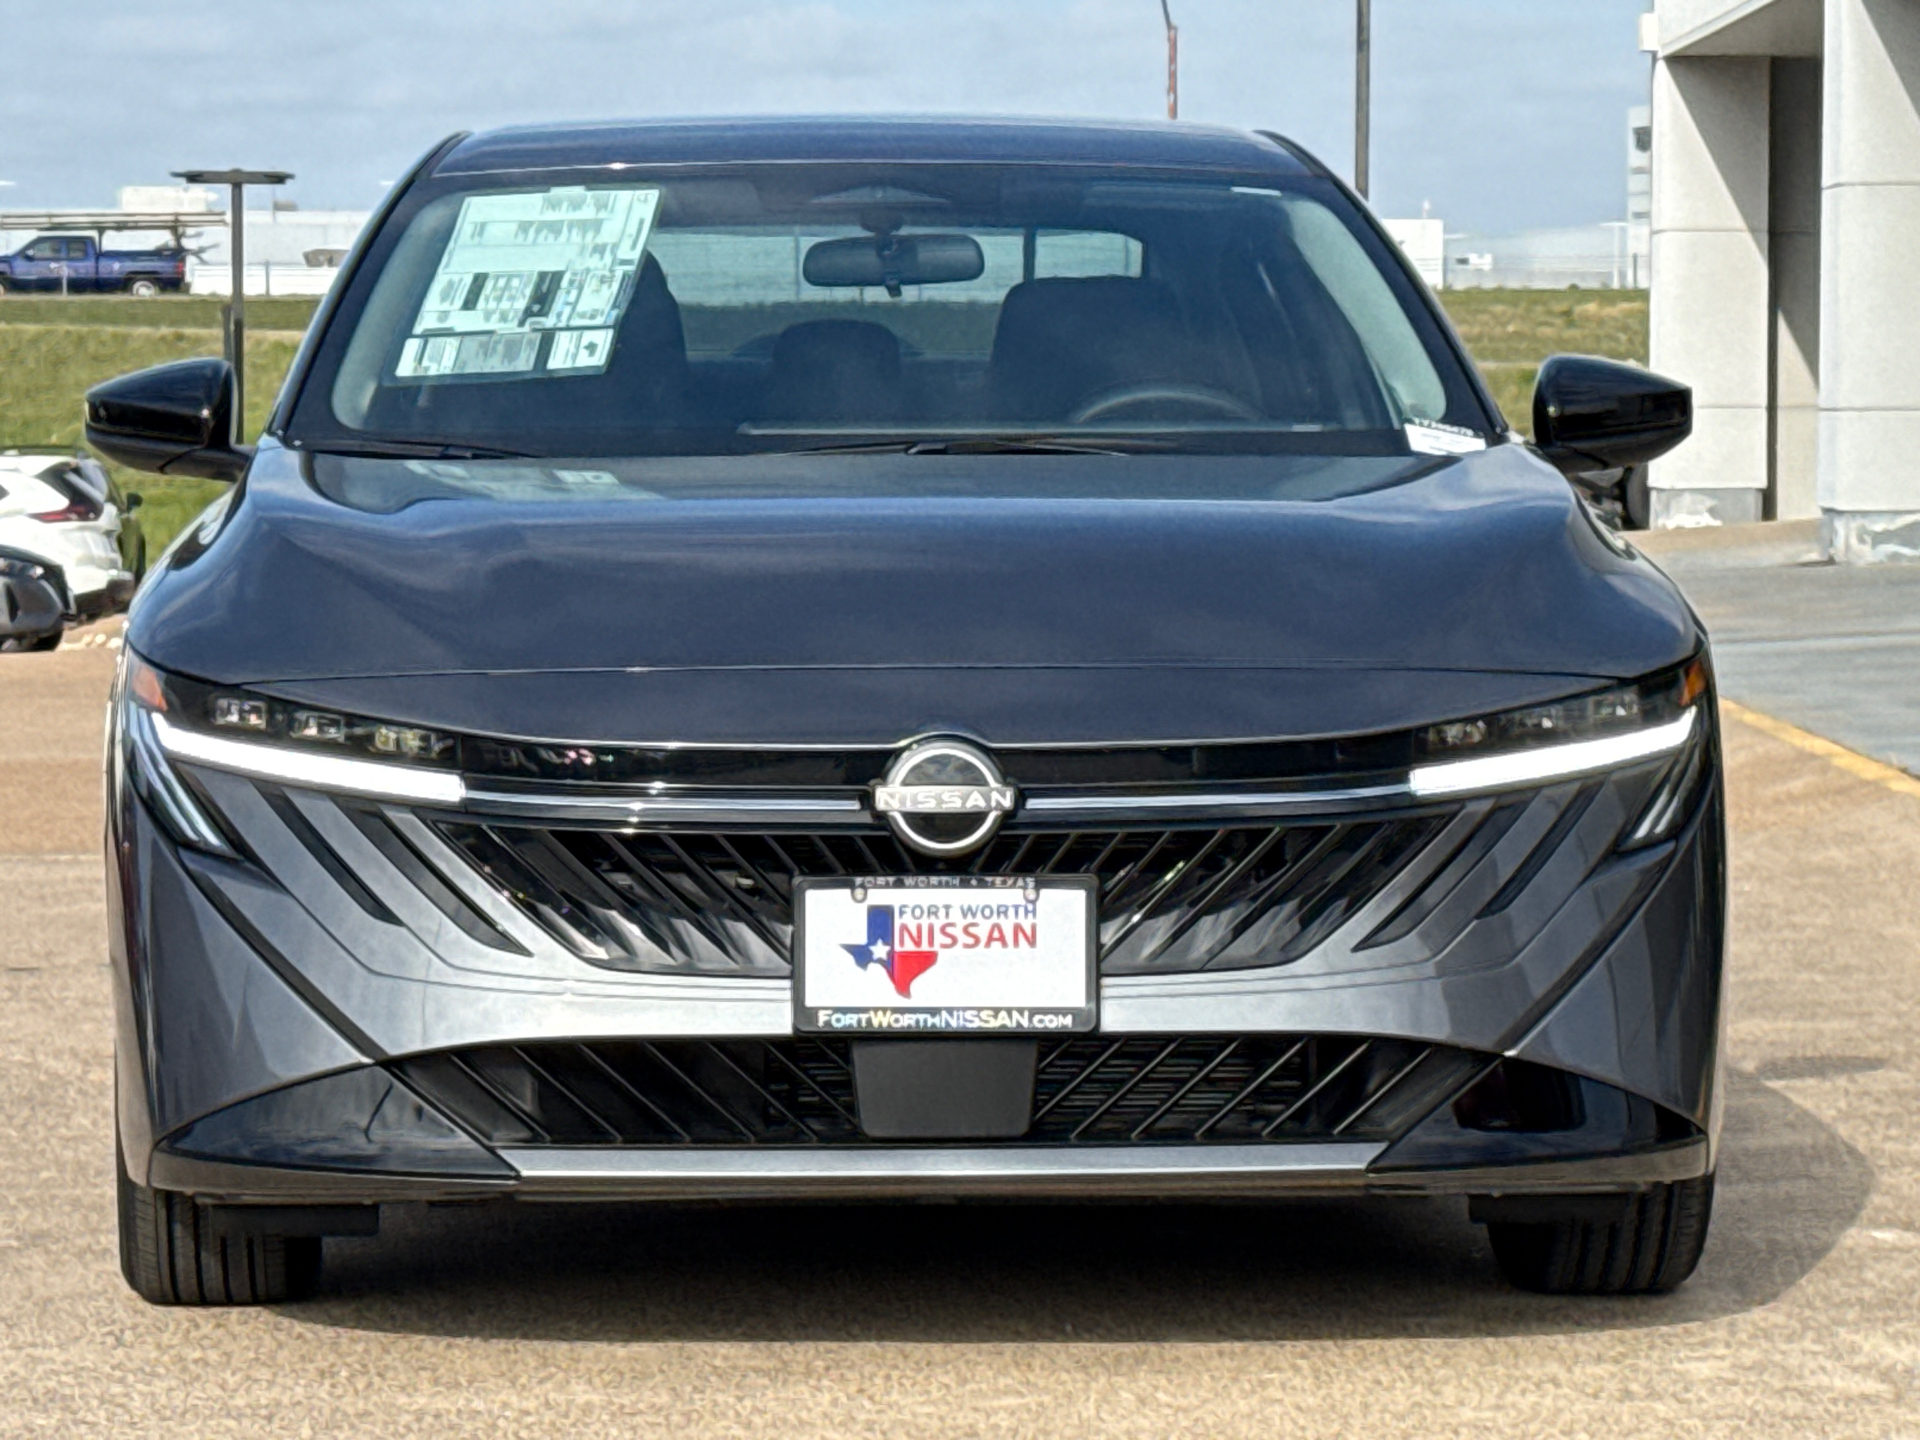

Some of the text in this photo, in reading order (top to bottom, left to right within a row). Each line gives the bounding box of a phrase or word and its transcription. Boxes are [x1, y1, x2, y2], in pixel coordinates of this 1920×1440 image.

[877, 790, 1014, 809] NISSAN
[854, 876, 1036, 888] FORT WORTH TEXAS
[898, 904, 1038, 920] FORT WORTH
[898, 922, 1038, 949] NISSAN
